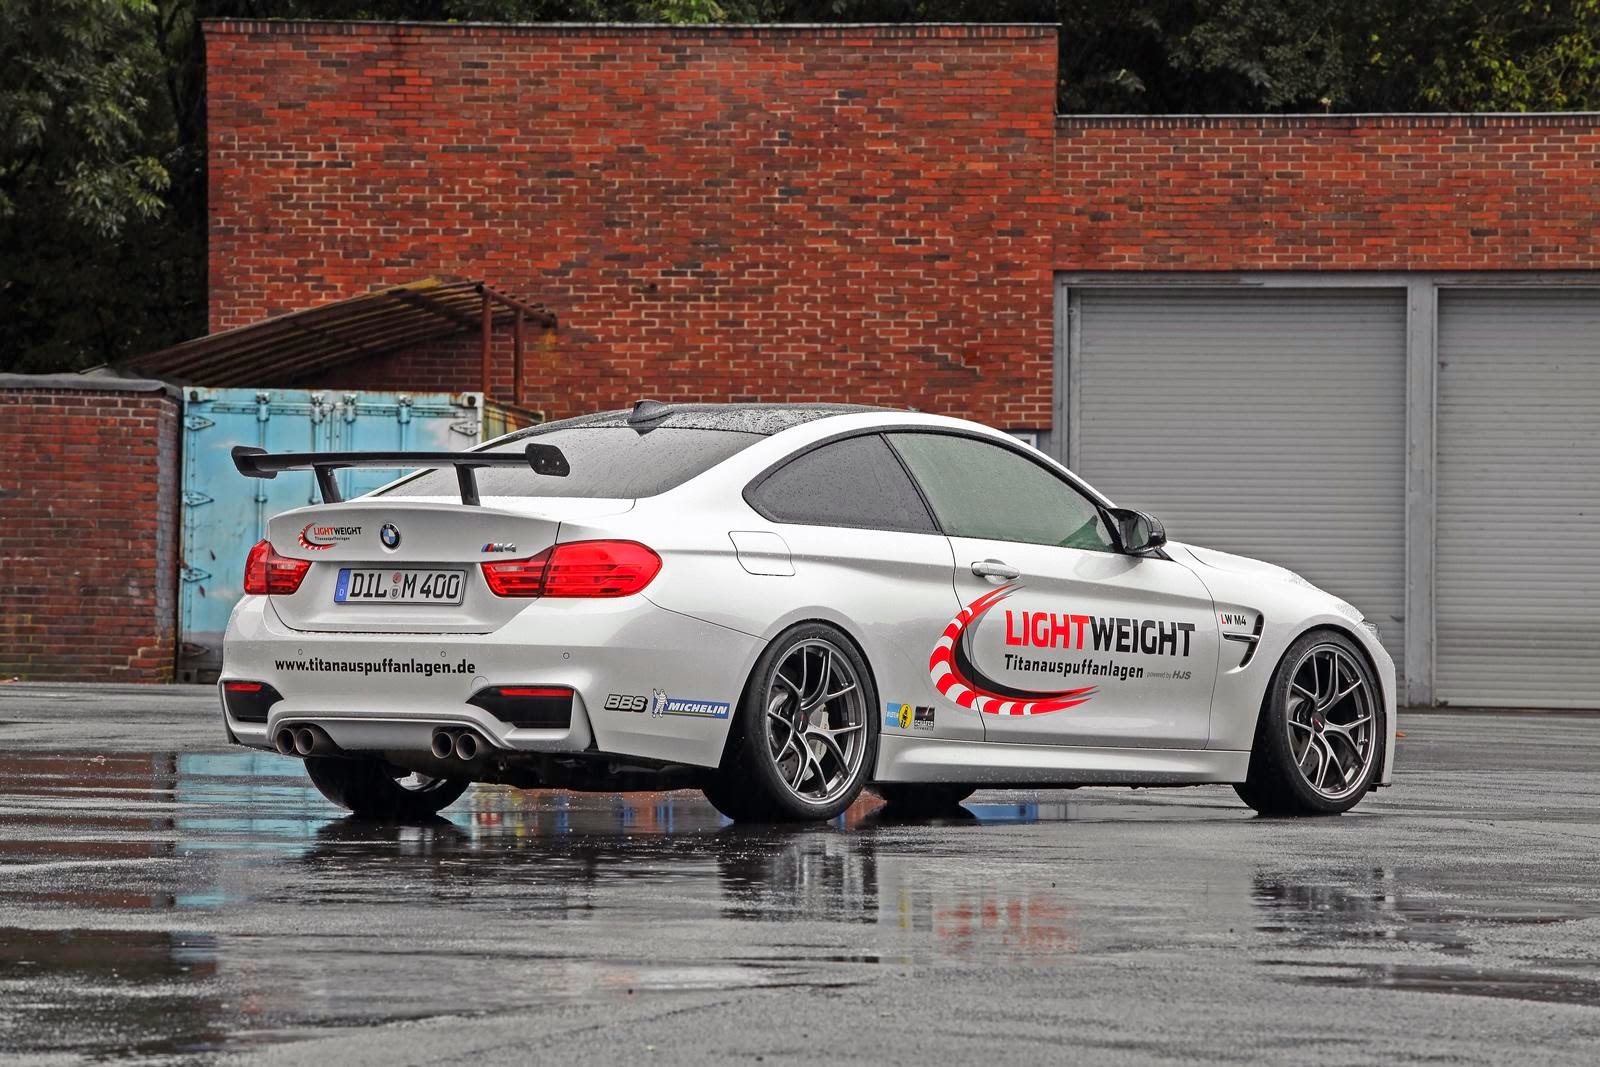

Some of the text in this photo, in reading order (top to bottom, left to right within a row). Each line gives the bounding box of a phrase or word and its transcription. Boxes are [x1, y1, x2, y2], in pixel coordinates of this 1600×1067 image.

[314, 526, 361, 536] LIGHTWEIGHT
[339, 588, 344, 597] D
[350, 573, 460, 599] DIL M 400
[1221, 614, 1247, 626] LW M4
[1005, 610, 1196, 657] LIGHTWEIGHT
[275, 657, 476, 676] www.titanauspuffanlagen.de
[1004, 654, 1144, 681] Titanauspuffanlagen
[1172, 670, 1192, 680] HJS
[604, 694, 649, 713] BBS
[667, 702, 728, 715] MICHELIN
